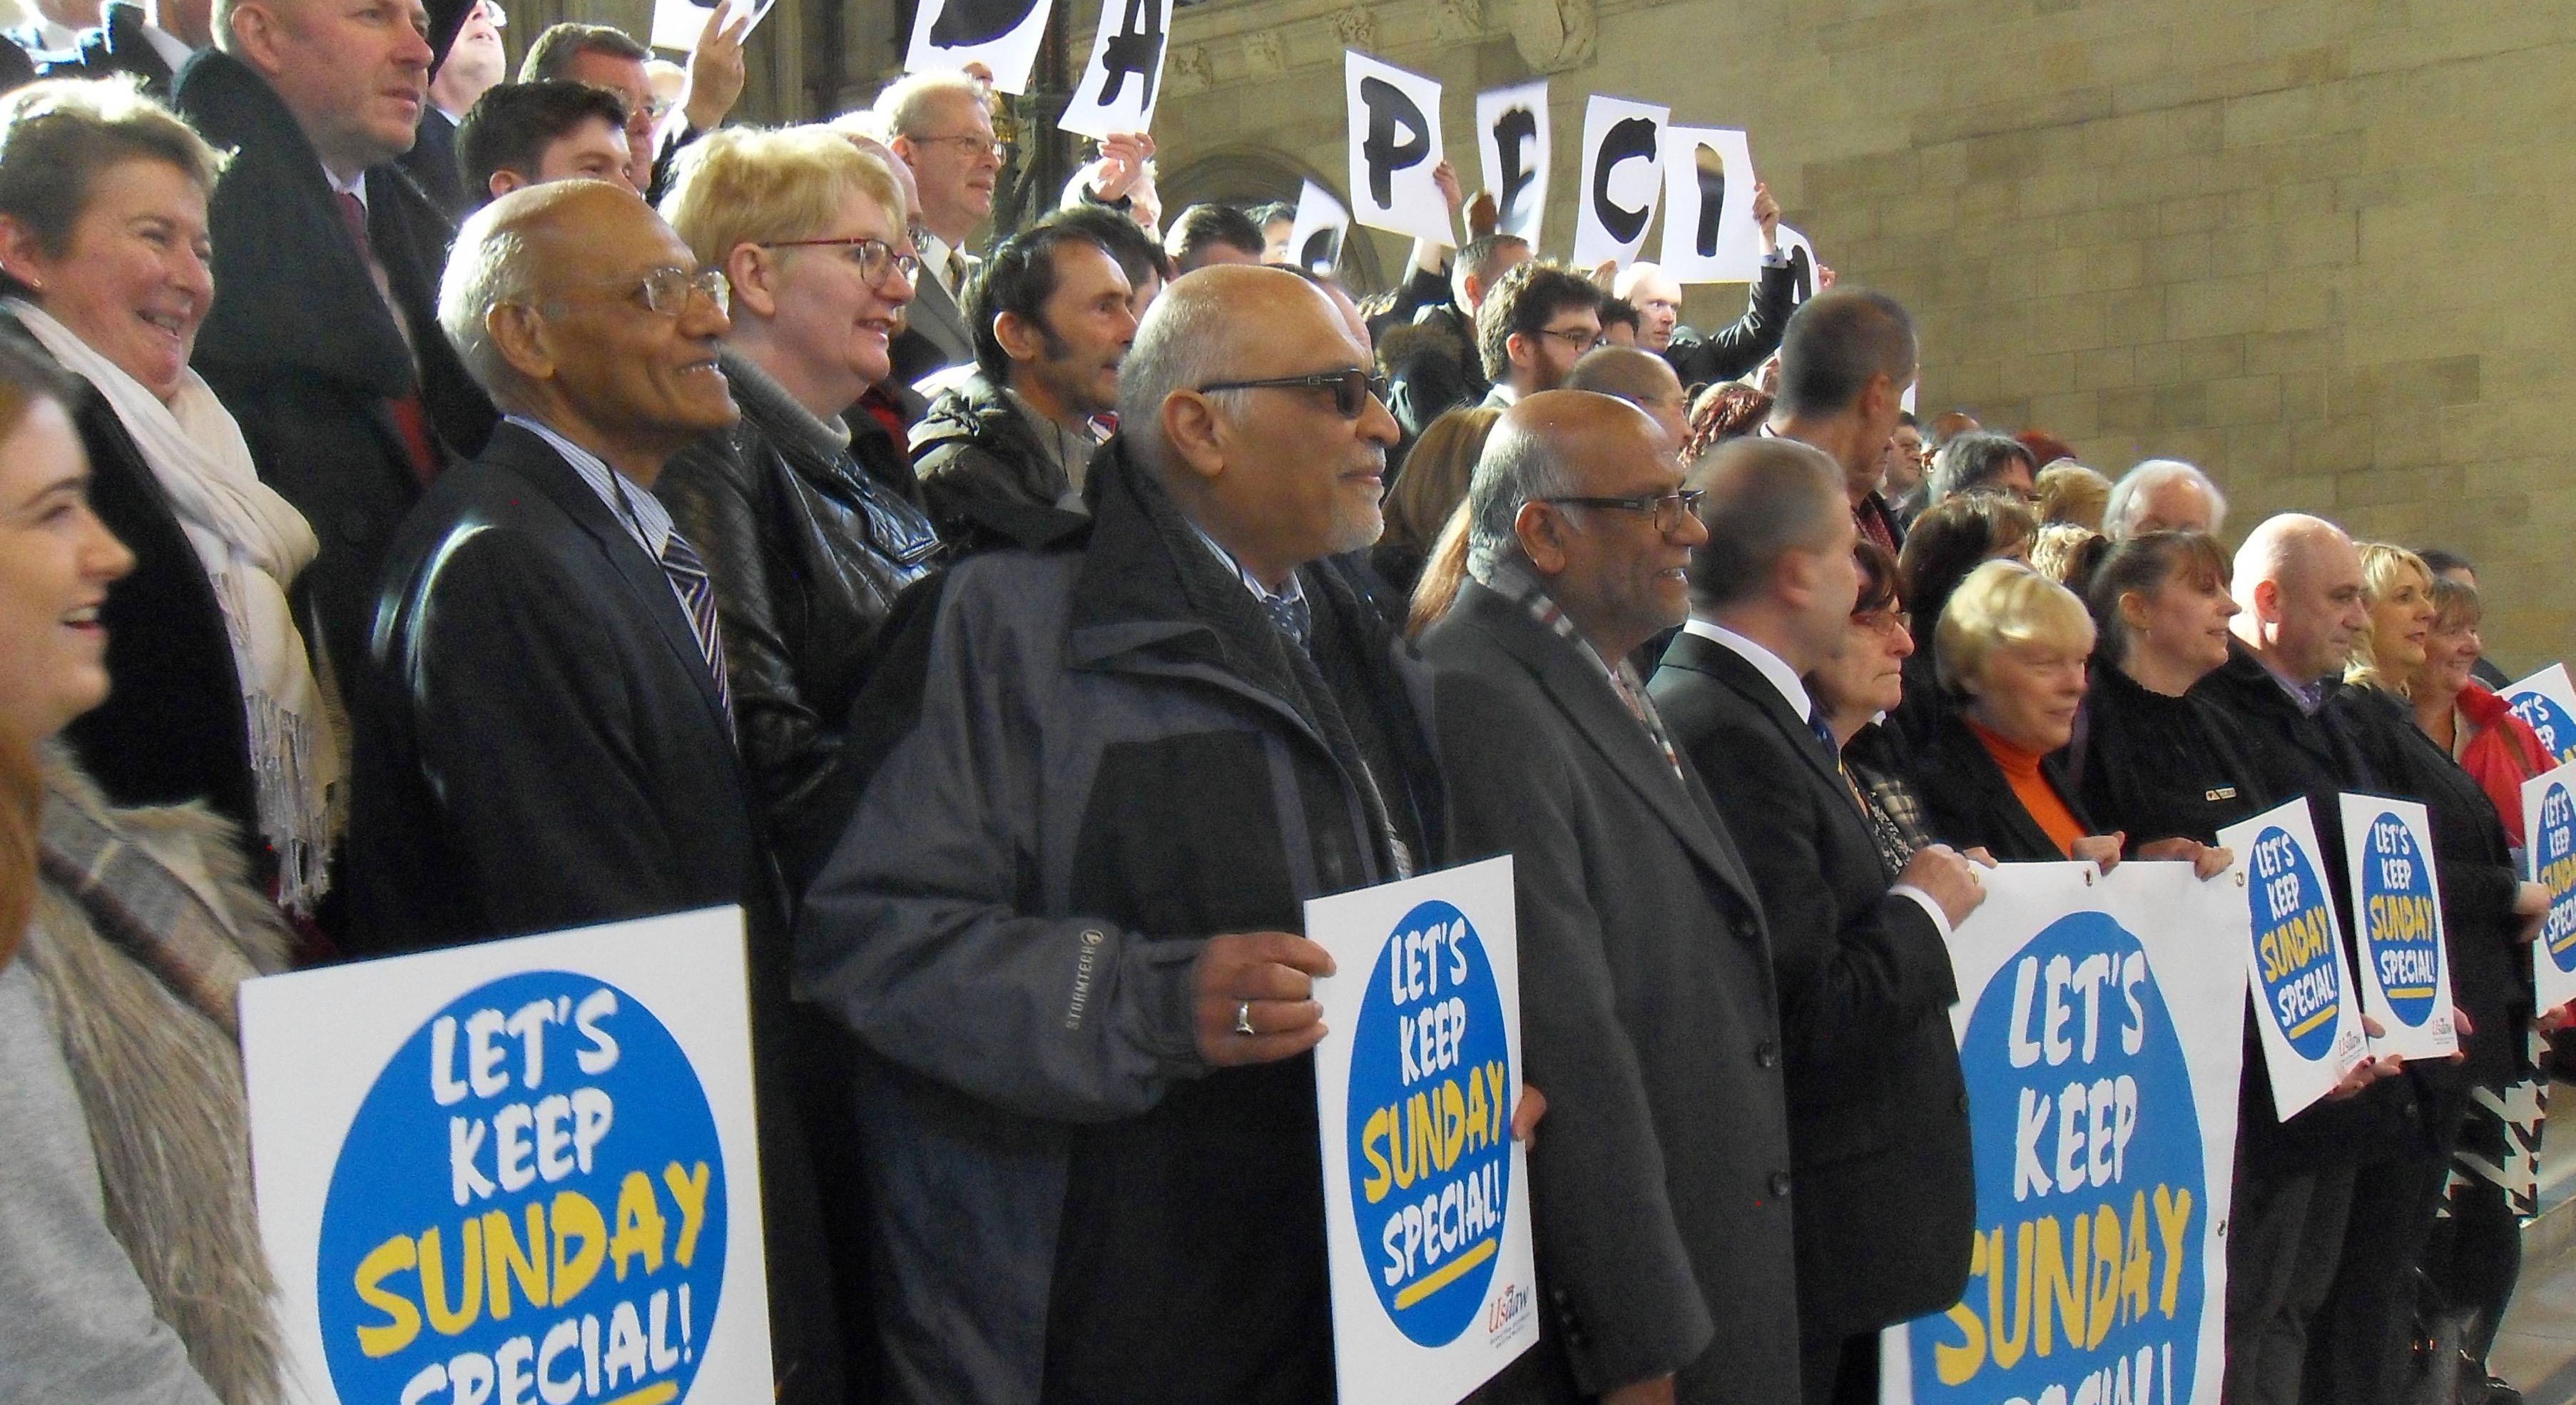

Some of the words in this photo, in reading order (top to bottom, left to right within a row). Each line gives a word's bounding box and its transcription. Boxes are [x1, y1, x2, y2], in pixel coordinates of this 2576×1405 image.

[1360, 76, 1430, 211] P
[1592, 117, 1657, 245] C
[1694, 142, 1724, 258] I
[2373, 821, 2409, 856] LET'S
[2545, 790, 2568, 828] LET'S
[2549, 826, 2570, 858] KEEP
[2255, 833, 2294, 879] LET'S
[2267, 873, 2300, 920] KEEP
[2381, 858, 2411, 891] KEEP
[1390, 917, 1467, 1006] LET'S
[2260, 905, 2329, 983] SUNDAY
[2369, 894, 2433, 943] SUNDAY
[1066, 945, 1096, 1030] STORMTECH
[2008, 950, 2146, 1069] LET'S
[2278, 963, 2338, 1027] SPECIAL!
[2381, 949, 2436, 985] SPECIAL!
[431, 988, 621, 1107] LET'S
[1401, 997, 1465, 1086] KEEP
[449, 1087, 612, 1207] KEEP
[1363, 1060, 1504, 1204] SUNDAY
[2014, 1075, 2138, 1202] KEEP
[355, 1160, 710, 1356] SUNDAY
[1383, 1160, 1501, 1287] SPECIAL!
[1935, 1183, 2191, 1386] SUNDAY
